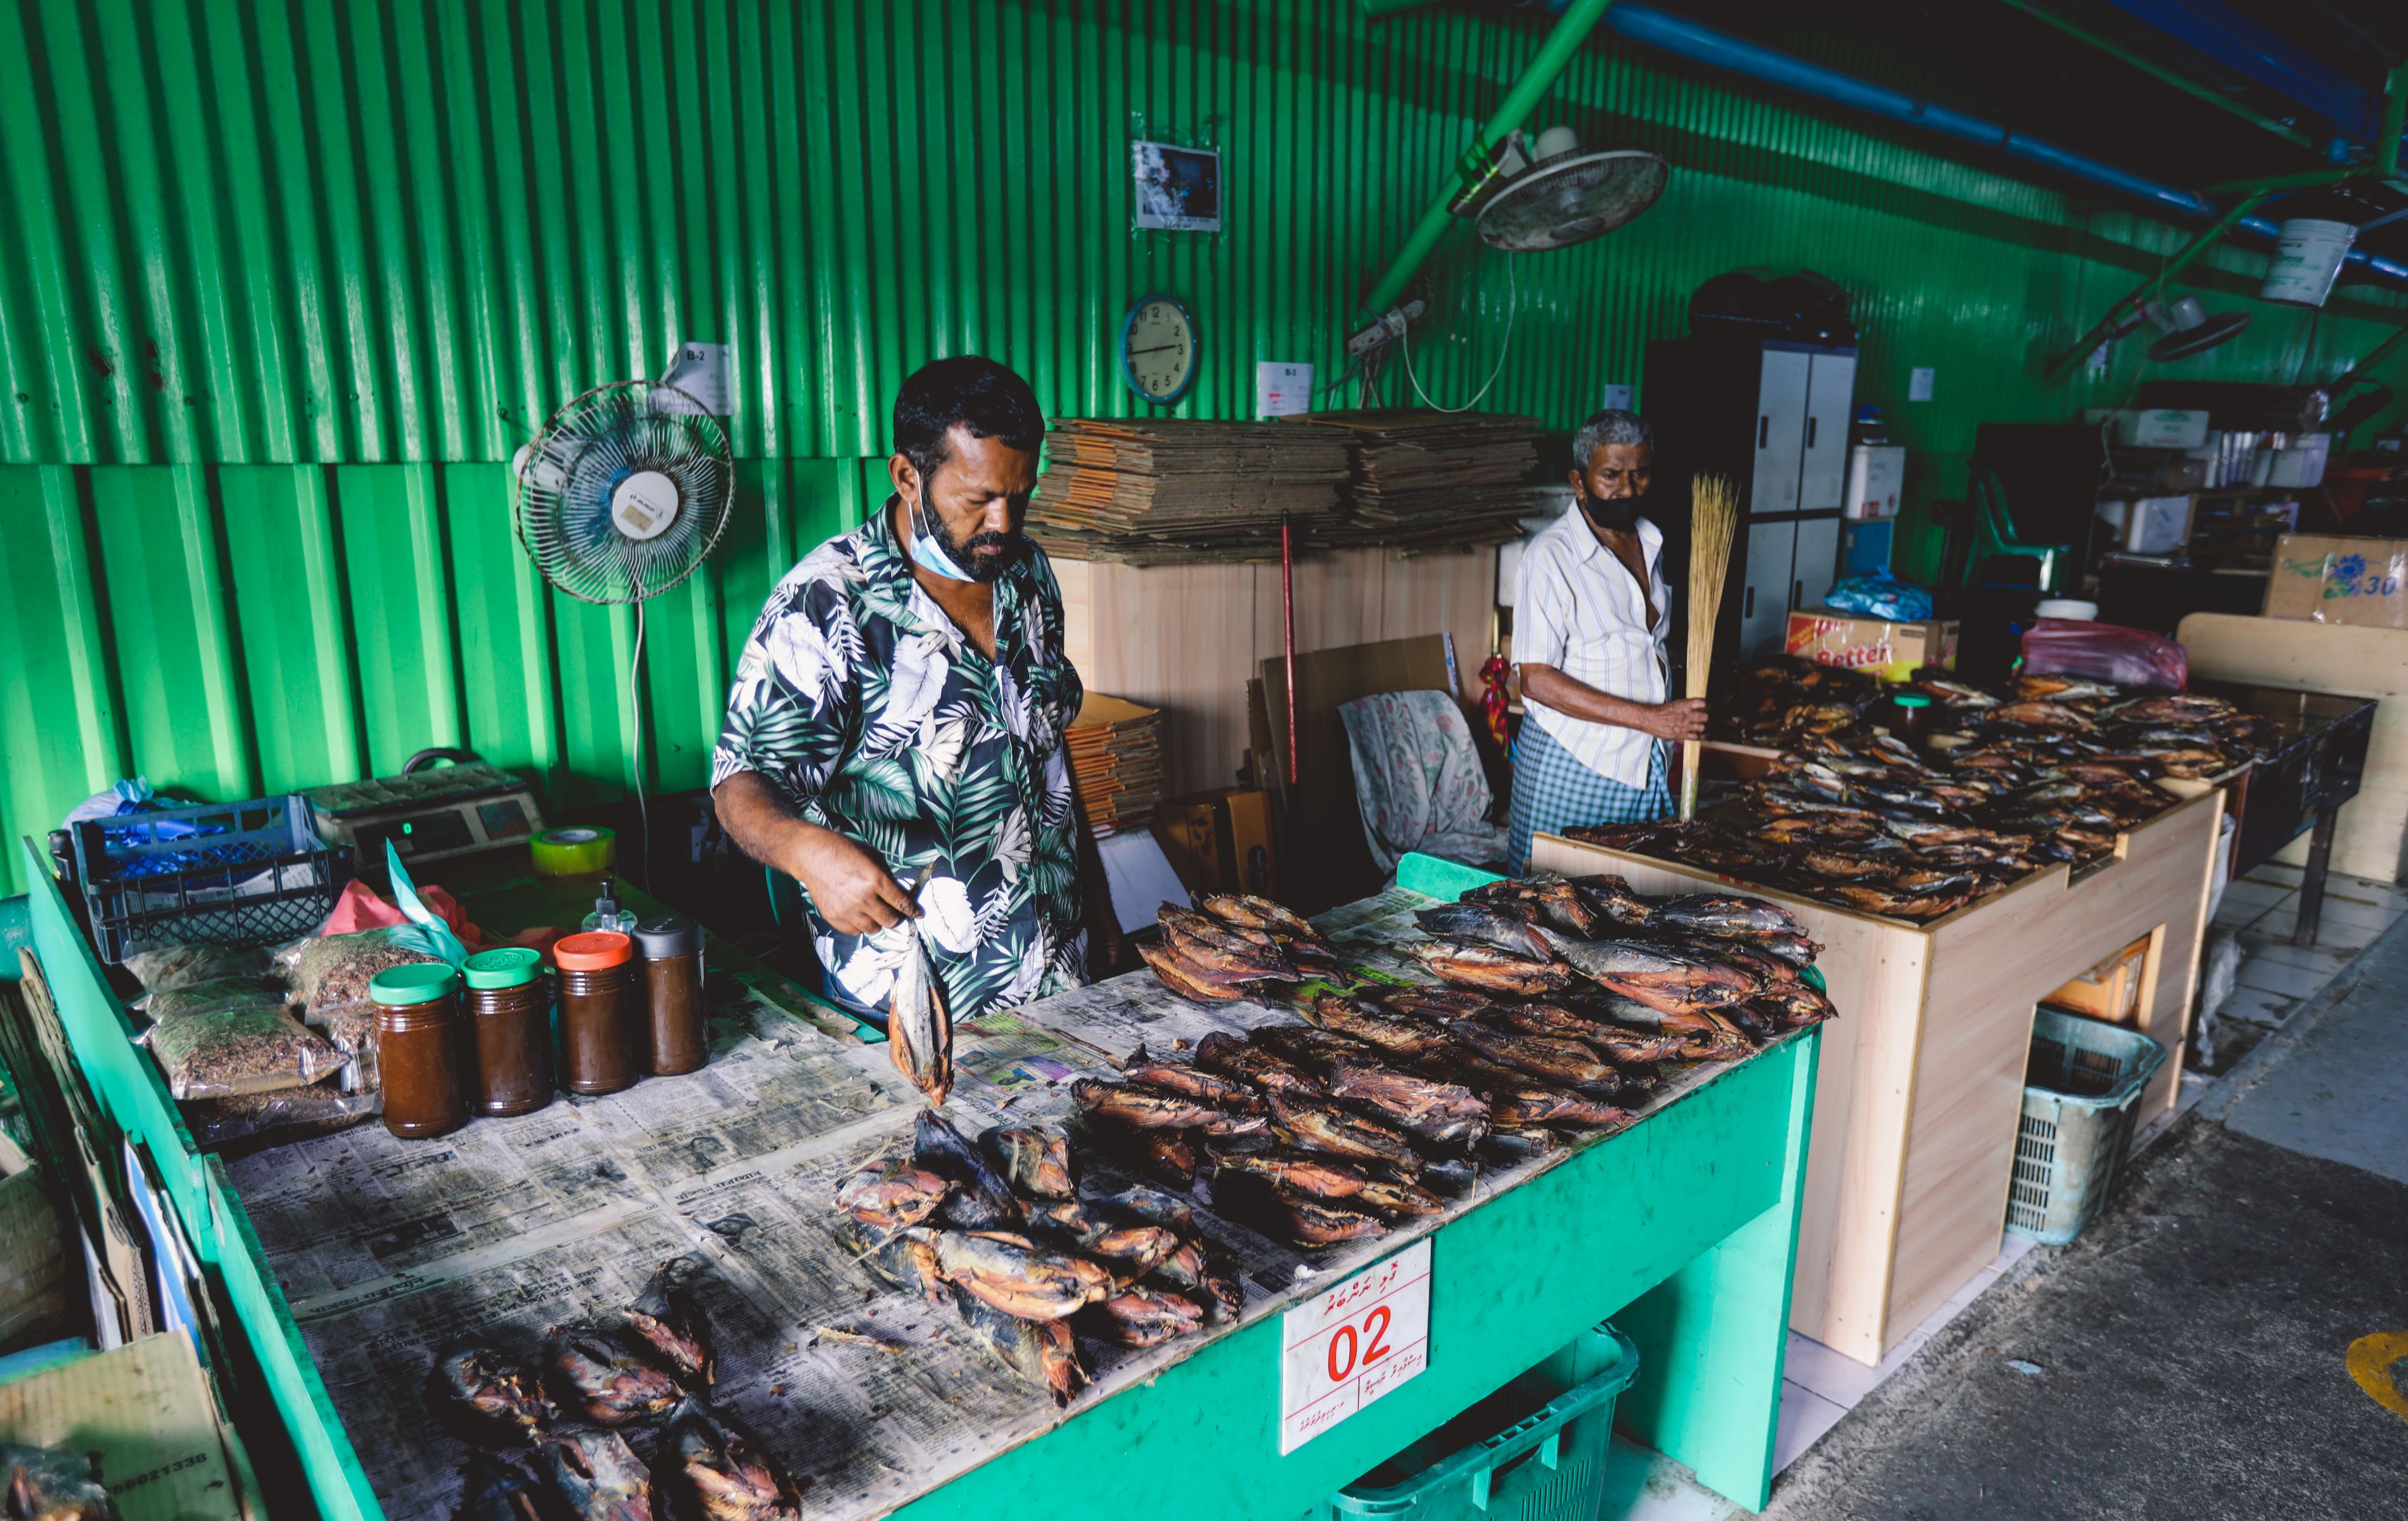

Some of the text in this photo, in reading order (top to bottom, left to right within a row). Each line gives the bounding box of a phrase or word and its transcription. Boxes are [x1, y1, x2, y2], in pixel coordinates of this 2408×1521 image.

[1140, 311, 1148, 321] 11
[1152, 306, 1160, 318] 12
[1174, 326, 1180, 337] 2
[1177, 343, 1184, 355] 3
[687, 350, 705, 361] B-2
[1131, 363, 1137, 373] 8
[1174, 363, 1180, 372] 4
[1141, 376, 1147, 387] 7
[1152, 380, 1158, 391] 6
[1165, 375, 1171, 386] 5
[2364, 576, 2397, 596] 30
[714, 1171, 762, 1190] राजस्थान
[1328, 1306, 1391, 1382] 02
